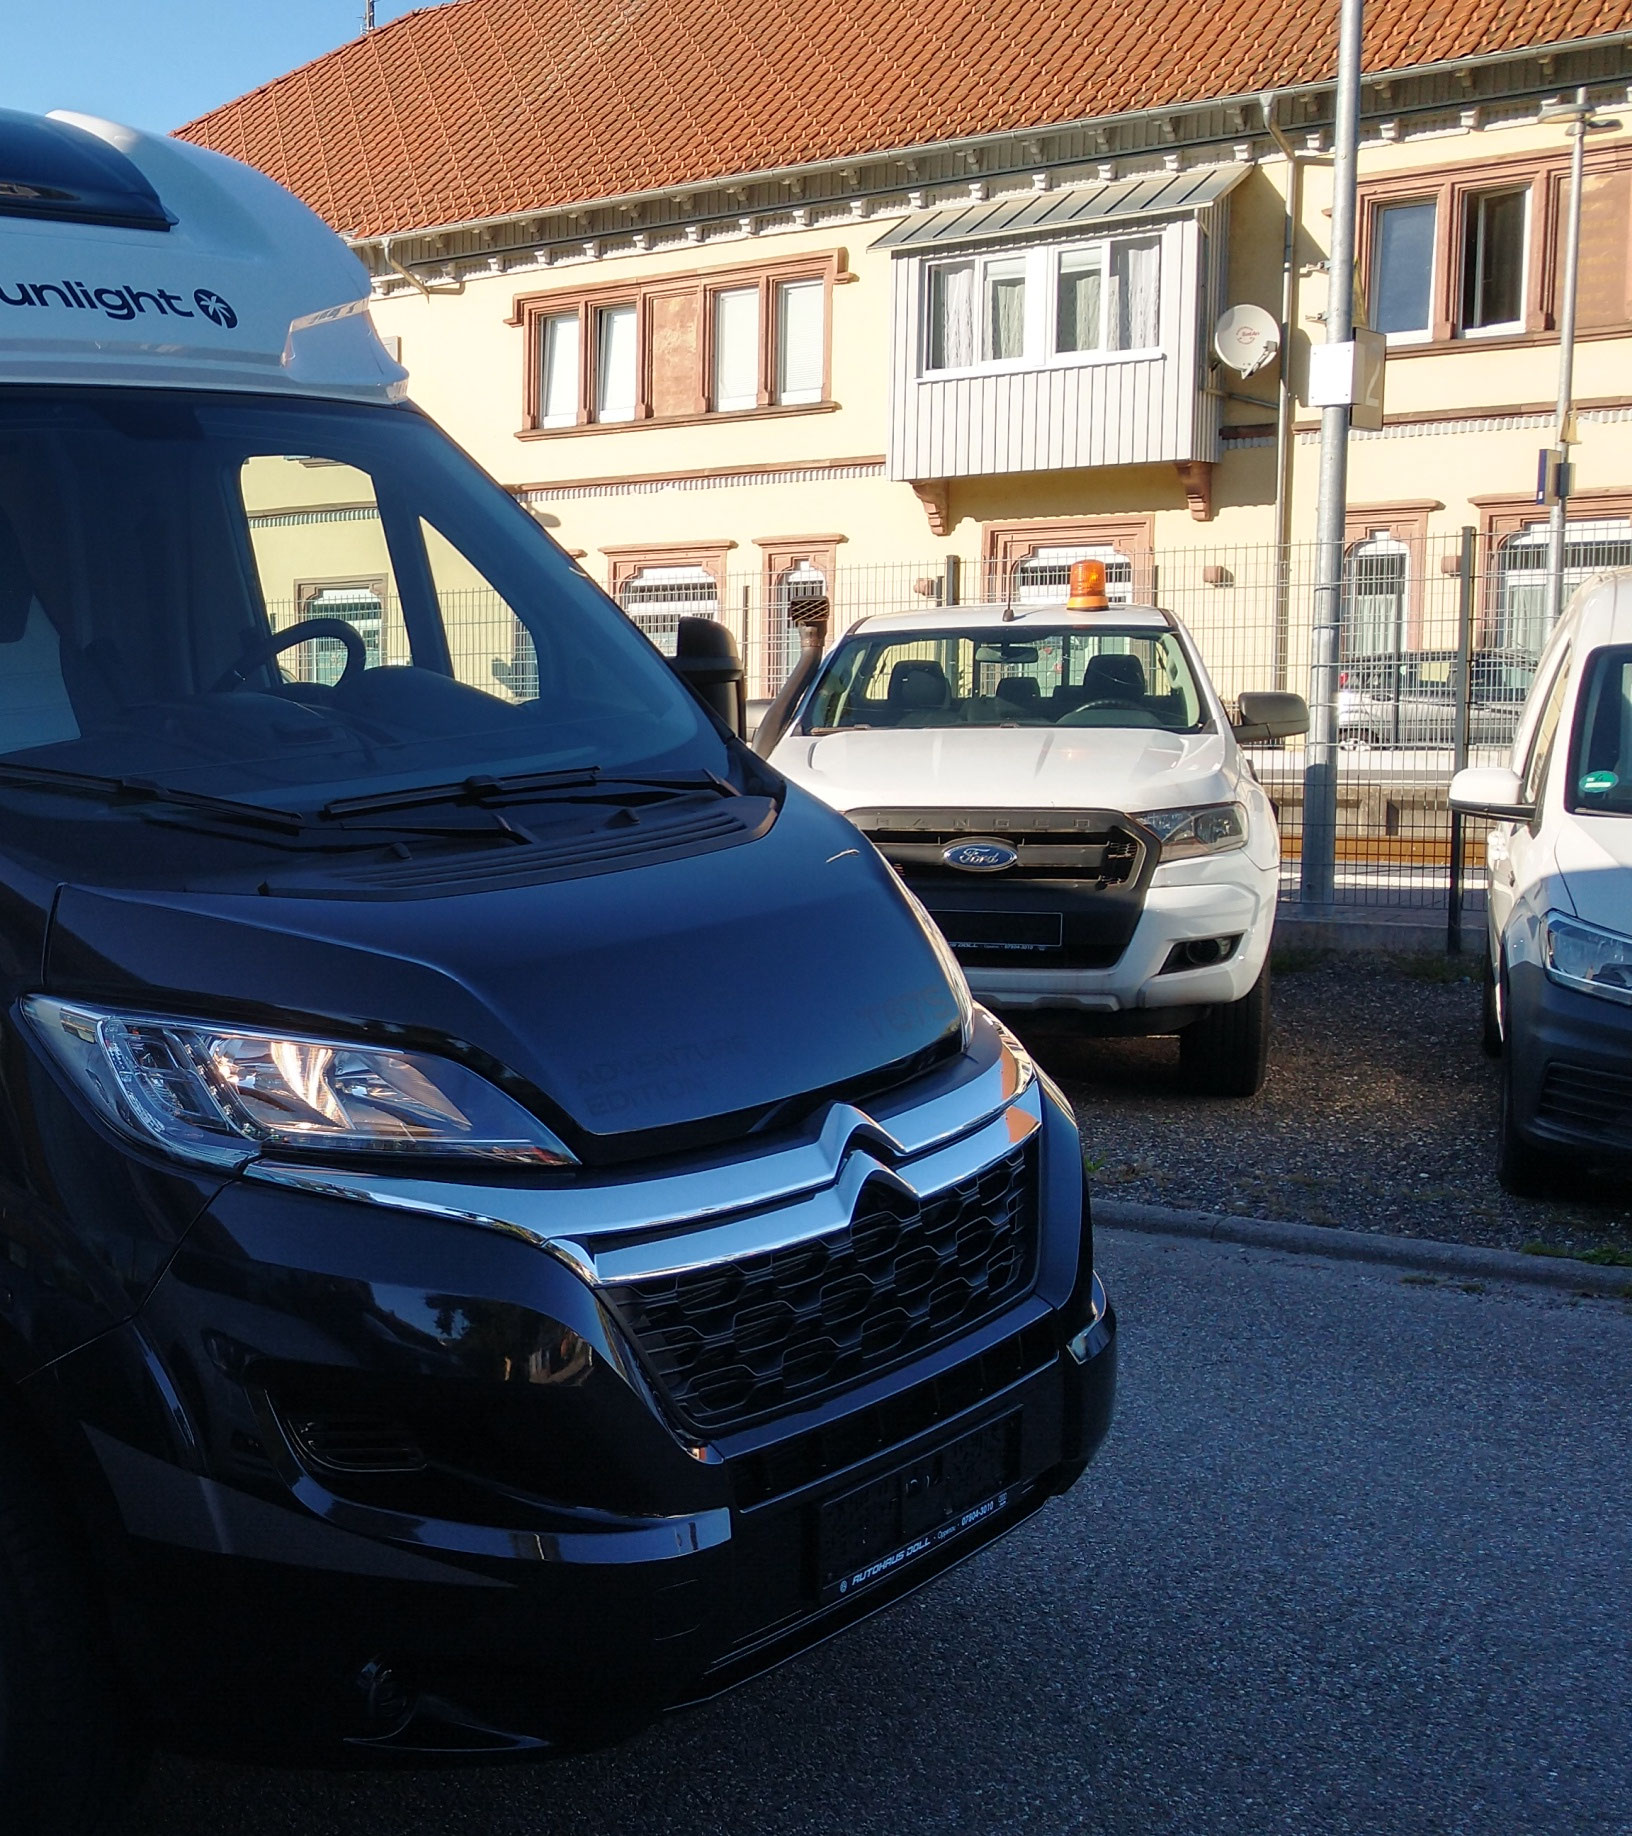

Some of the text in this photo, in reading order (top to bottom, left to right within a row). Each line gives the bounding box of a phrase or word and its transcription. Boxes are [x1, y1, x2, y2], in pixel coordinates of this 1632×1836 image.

[959, 847, 999, 864] Ford
[852, 1550, 905, 1585] AUTOHAUS
[906, 1537, 931, 1557] DOLL
